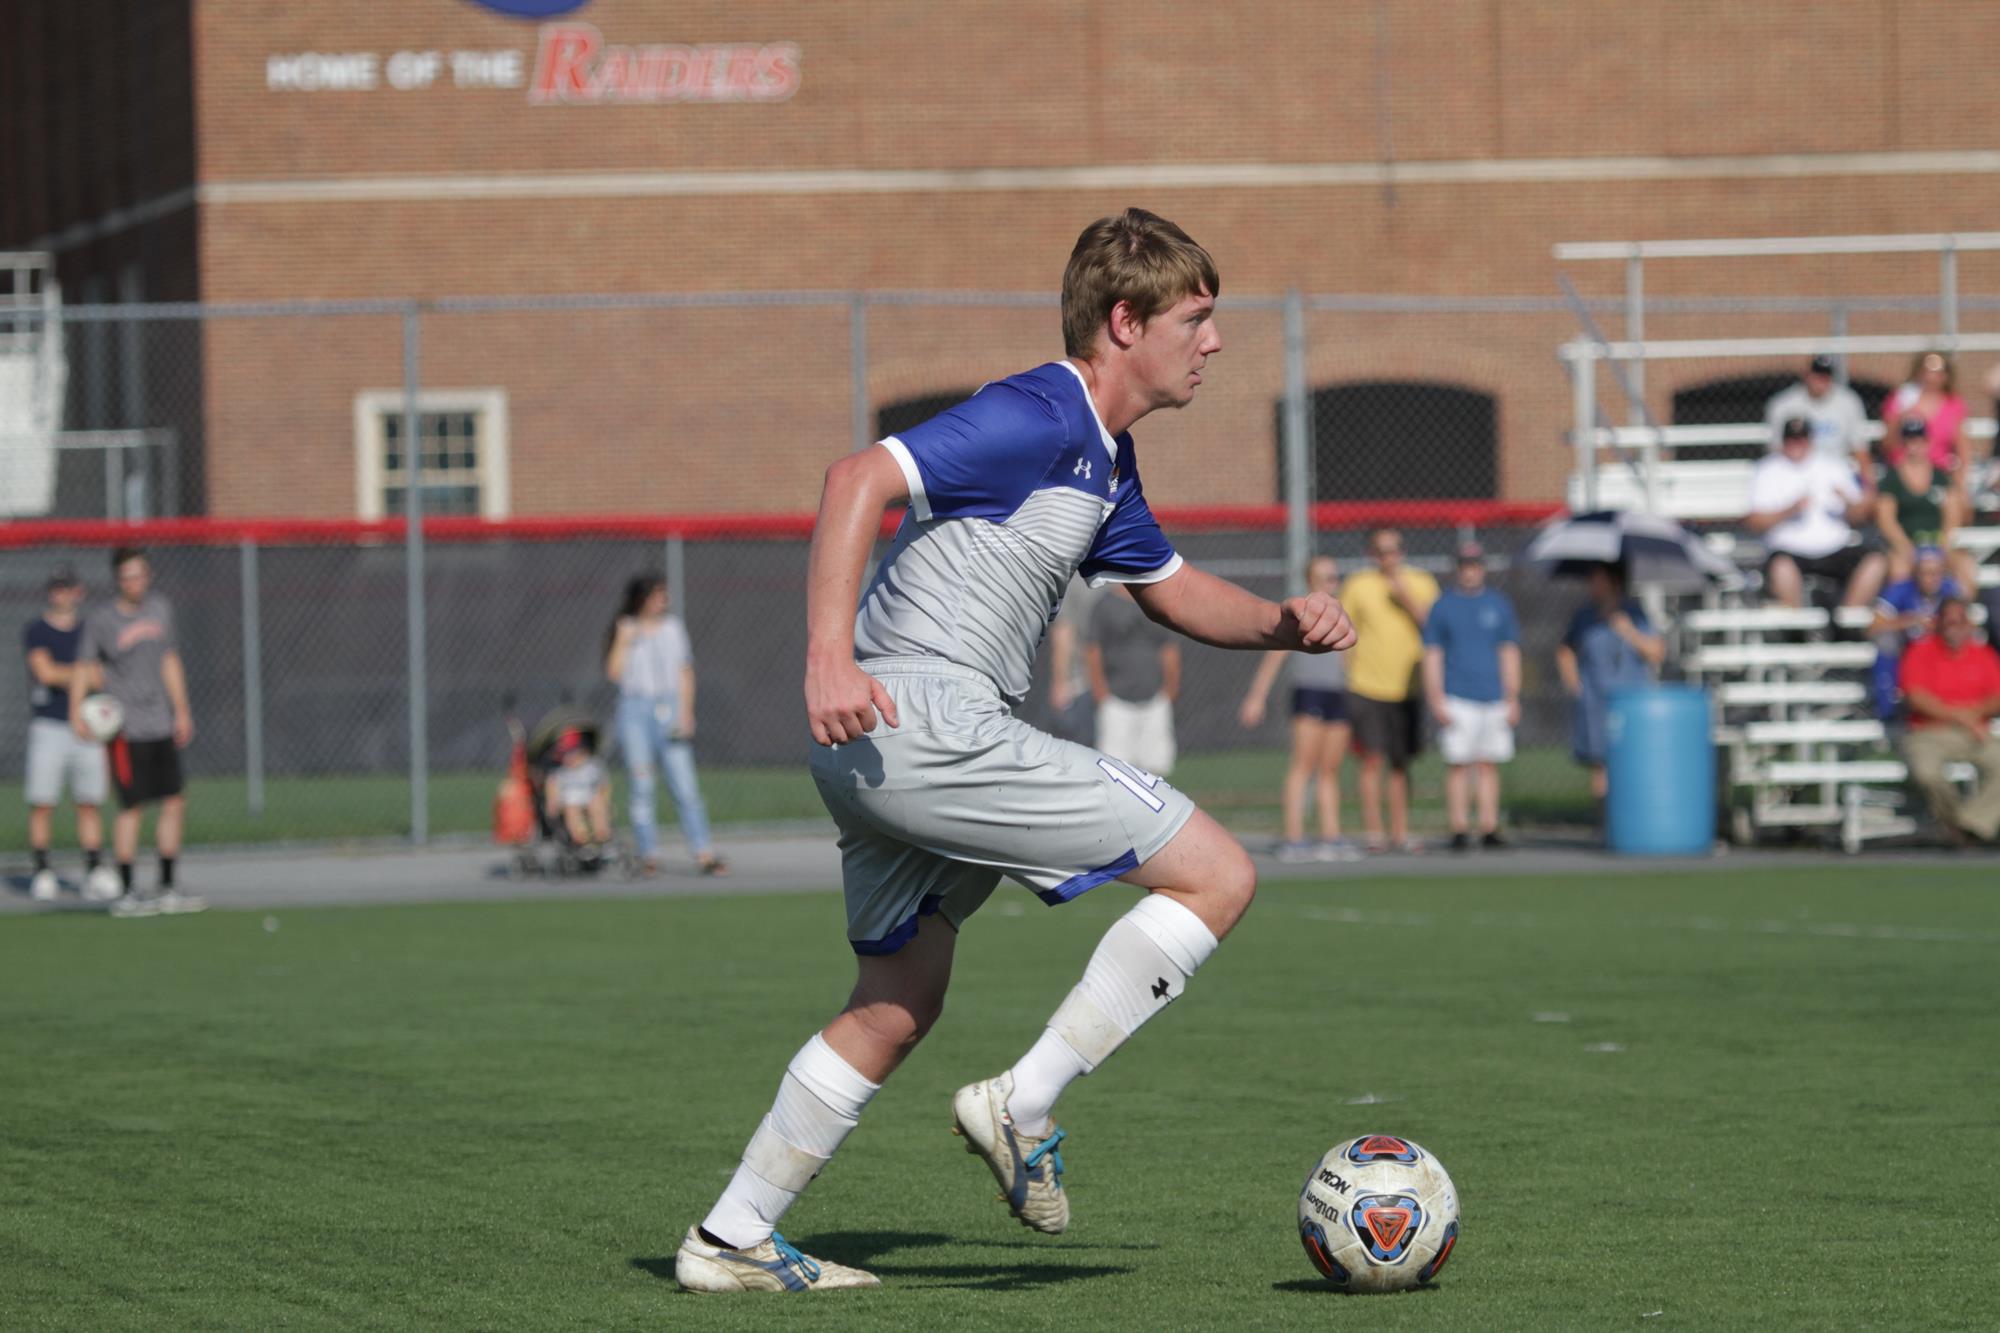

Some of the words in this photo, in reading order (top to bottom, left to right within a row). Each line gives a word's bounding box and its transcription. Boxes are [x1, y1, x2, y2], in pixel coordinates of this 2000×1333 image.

[267, 53, 377, 90] HOME
[387, 51, 441, 90] OF
[450, 50, 522, 88] THE
[531, 24, 800, 103] RAIDERS
[1318, 1168, 1352, 1195] NCAA
[1306, 1190, 1339, 1224] Wilson
